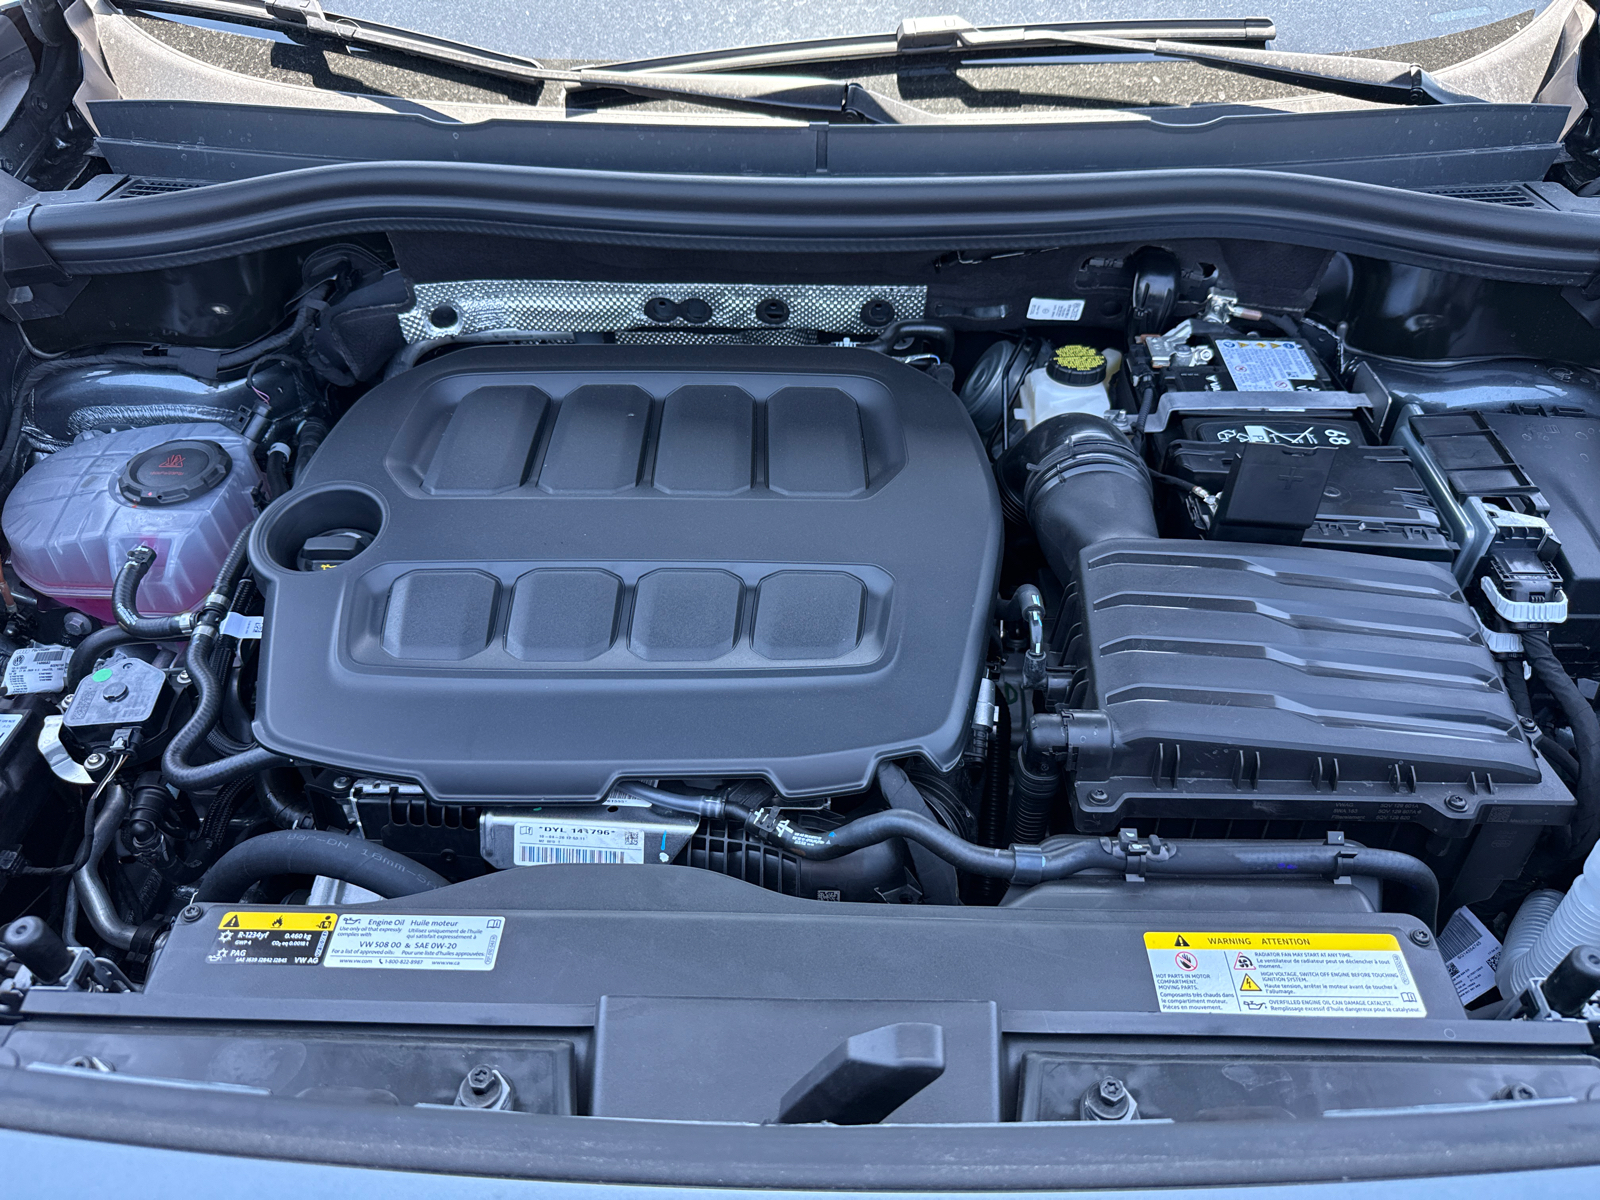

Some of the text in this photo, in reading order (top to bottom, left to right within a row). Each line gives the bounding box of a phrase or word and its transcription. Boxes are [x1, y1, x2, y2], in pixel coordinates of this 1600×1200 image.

[1324, 429, 1351, 446] 68
[368, 919, 393, 927] Engine
[237, 931, 270, 940] R-1234yf
[304, 932, 312, 941] kg
[1207, 937, 1310, 946] WARNING ATTENTION
